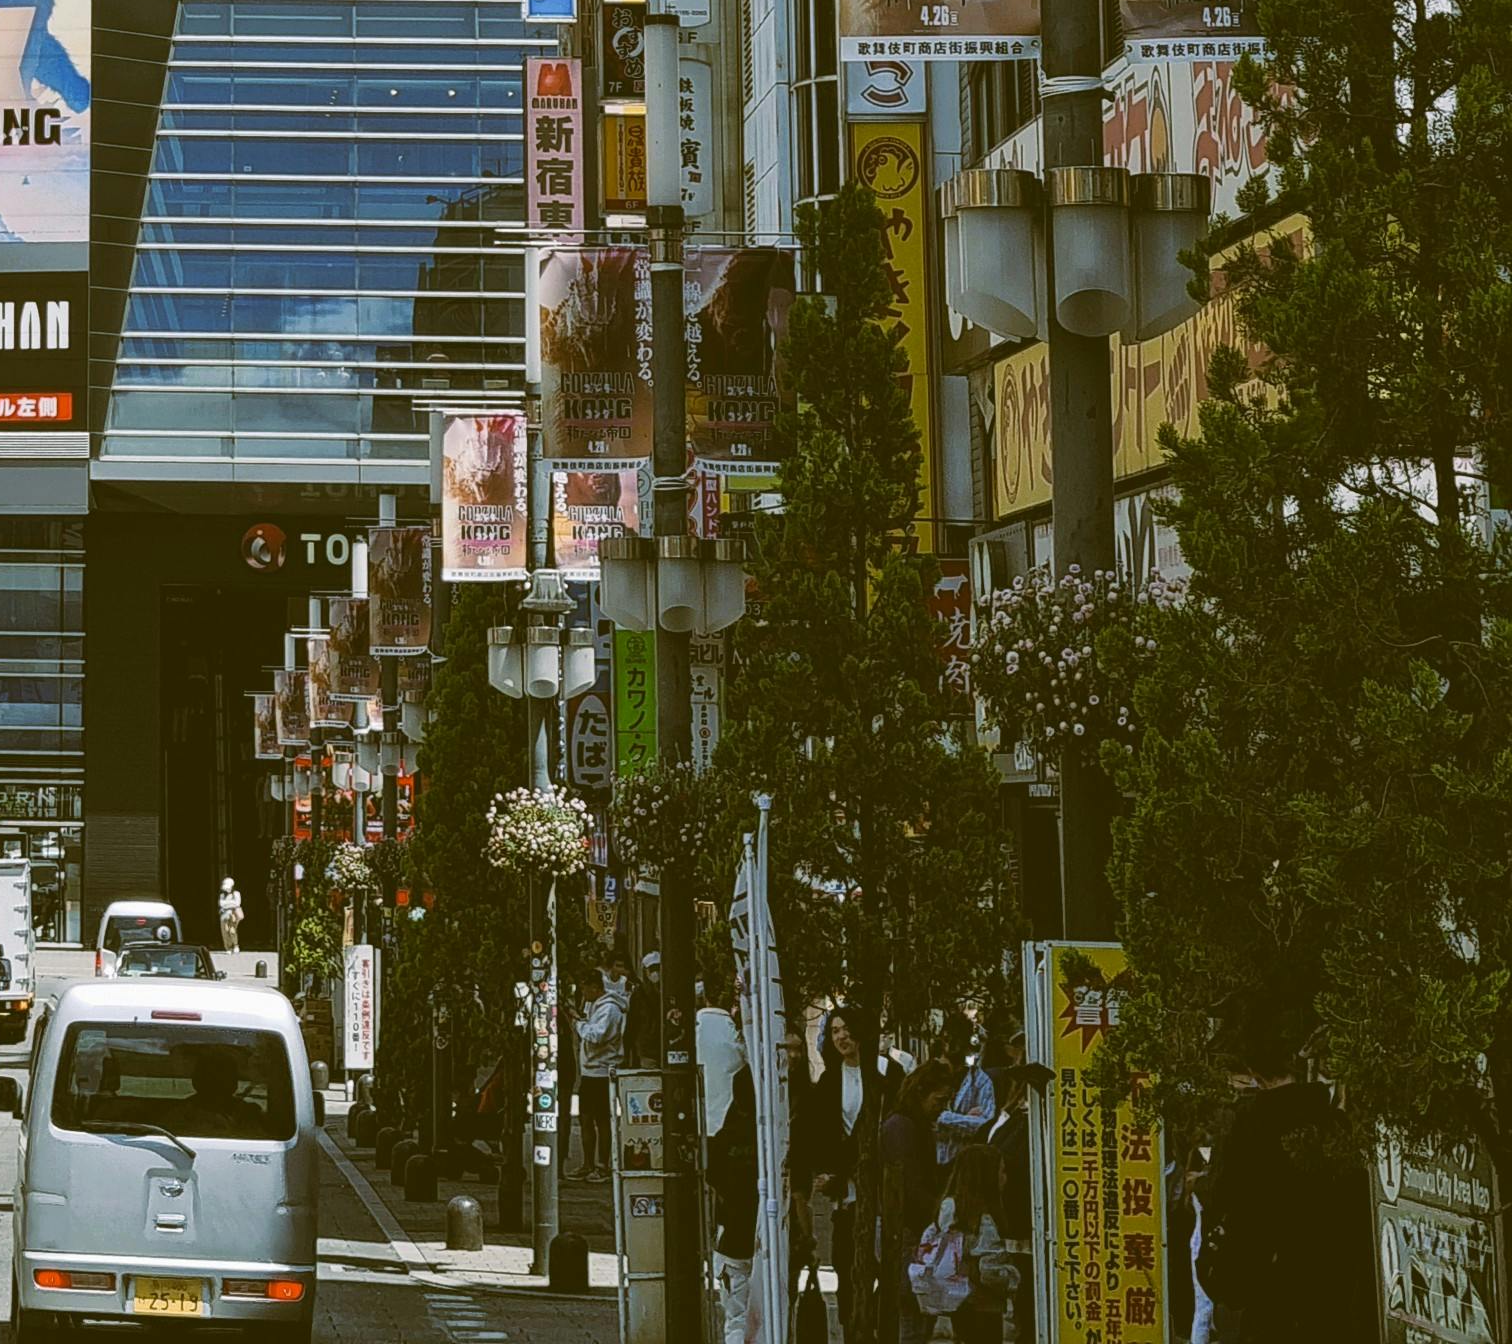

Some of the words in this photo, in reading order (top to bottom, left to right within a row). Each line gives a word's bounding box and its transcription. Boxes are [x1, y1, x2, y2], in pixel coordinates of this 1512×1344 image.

[857, 41, 1026, 58] 歌舞伎町商店街振興組合
[608, 81, 623, 94] 7F
[564, 398, 632, 419] KONG
[461, 524, 511, 540] KONG
